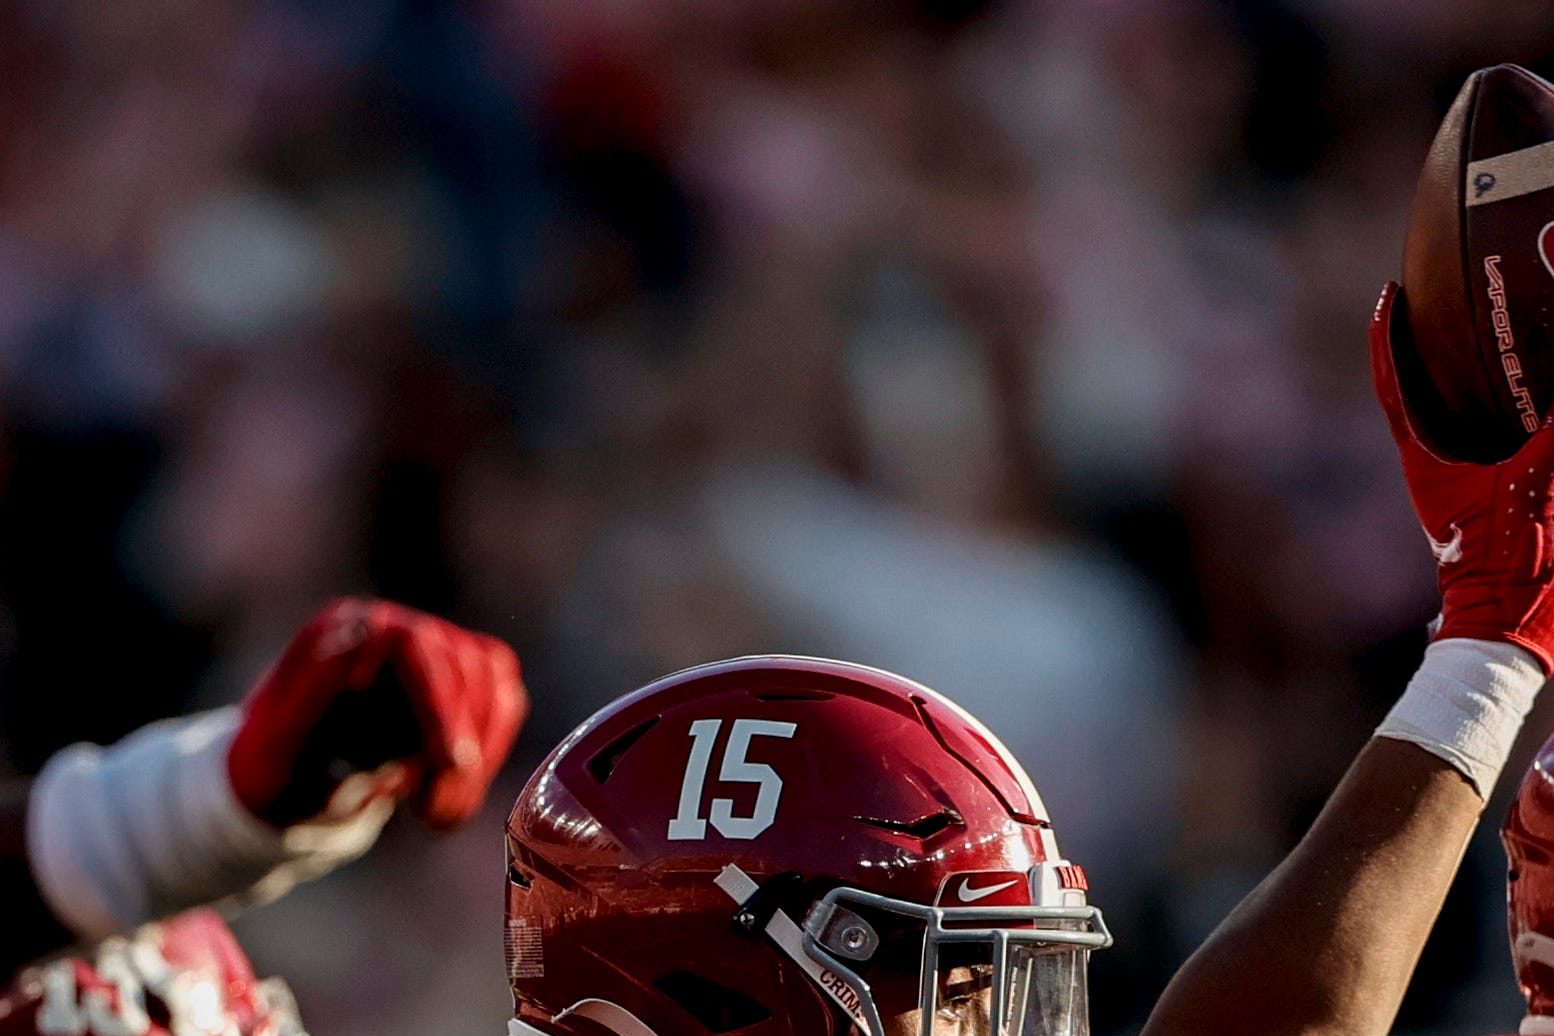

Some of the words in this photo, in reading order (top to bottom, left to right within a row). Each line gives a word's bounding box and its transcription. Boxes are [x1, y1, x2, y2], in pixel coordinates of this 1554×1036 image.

[1484, 255, 1514, 351] VAPOR
[1501, 353, 1540, 433] ELITE
[667, 719, 798, 840] 15
